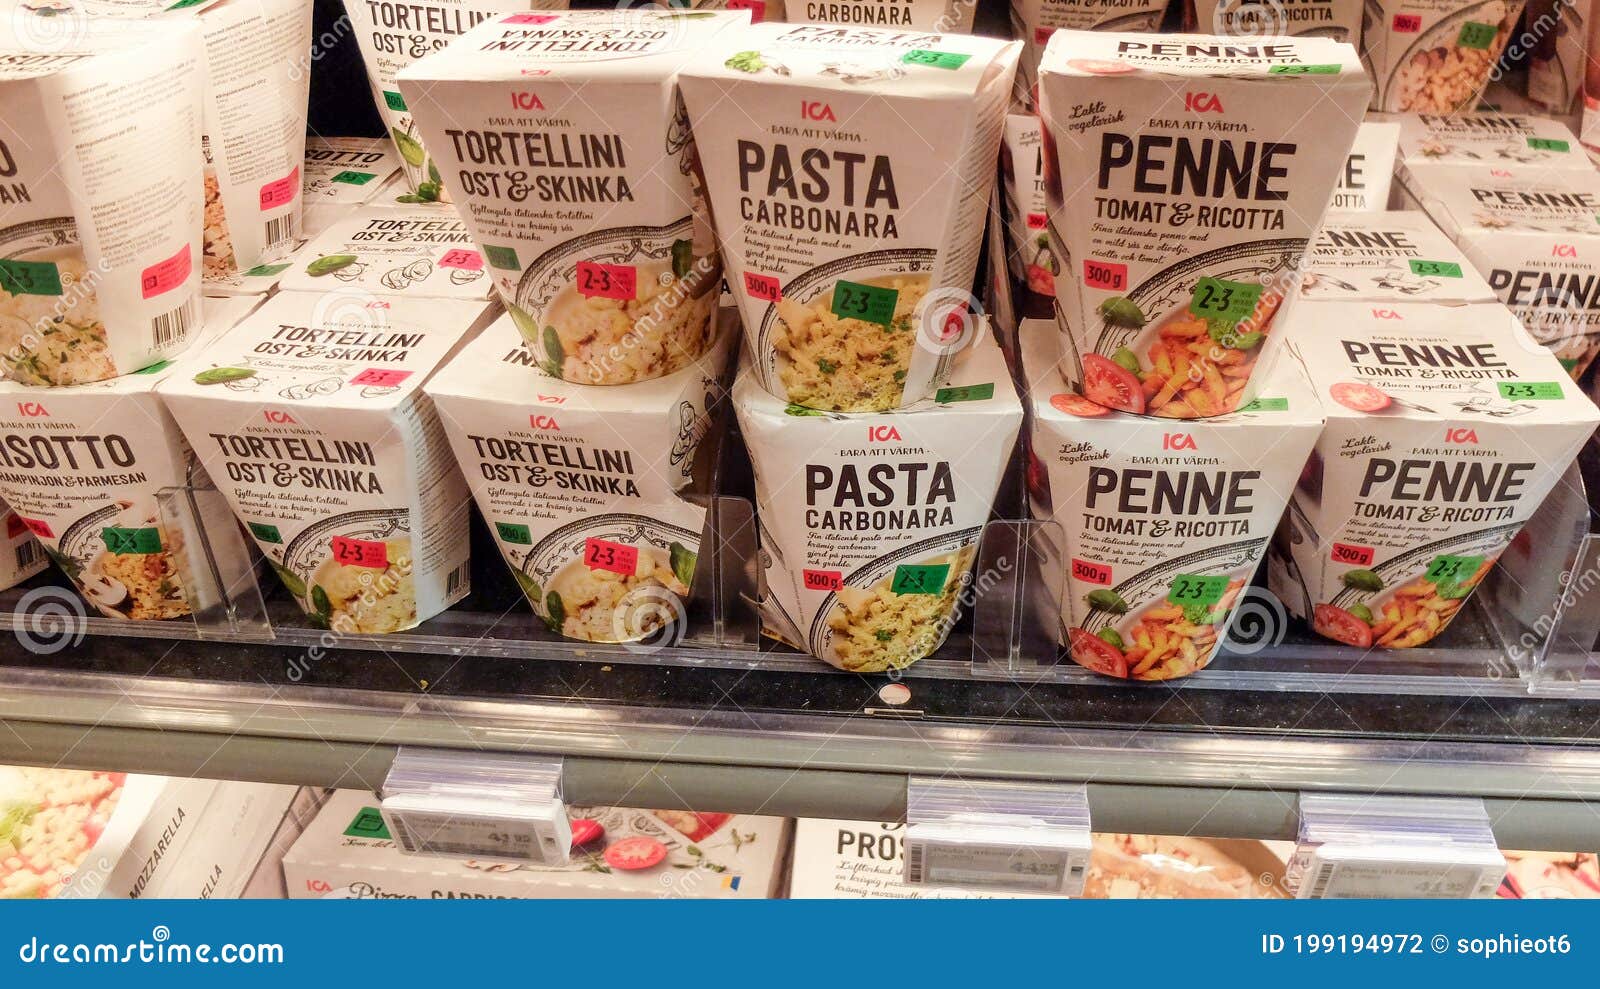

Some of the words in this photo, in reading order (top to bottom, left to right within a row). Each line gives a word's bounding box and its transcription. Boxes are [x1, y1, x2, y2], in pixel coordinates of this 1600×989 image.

[807, 4, 913, 25] CARBONARA
[1280, 8, 1333, 22] RICOTTA
[789, 26, 943, 43] PASTA
[373, 32, 404, 53] OST
[409, 35, 431, 59] &
[1118, 41, 1295, 58] PENNE
[1118, 54, 1181, 63] TOMAT
[512, 93, 545, 110] ICA
[1185, 92, 1224, 114] ICA
[801, 101, 836, 122] ICA
[1069, 102, 1107, 119] Lakto
[488, 118, 514, 126] BARA
[518, 118, 535, 127] ATT
[537, 117, 570, 128] VÄRMA
[1069, 110, 1126, 133] vegetarisk
[1150, 118, 1178, 129] BARA
[1180, 119, 1201, 131] ATT
[1204, 118, 1248, 133] VÄRMA
[771, 125, 799, 136] BARA
[801, 127, 820, 138] ATT
[823, 127, 861, 142] VÄRMA
[446, 130, 626, 169] TORTELLINI
[737, 139, 899, 210] PASTA
[1098, 132, 1297, 201] PENNE
[460, 170, 501, 199] OST
[507, 171, 536, 202] &
[539, 176, 634, 202] SKINKA
[1470, 188, 1600, 208] PENNE
[740, 197, 899, 239] CARBONARA
[1095, 197, 1166, 225] TOMAT
[1168, 202, 1194, 227] &
[1197, 206, 1285, 230] RICOTTA
[351, 231, 388, 241] OST
[412, 232, 473, 243] SKINK
[1115, 225, 1158, 239] italienska
[1159, 231, 1188, 241] penne
[1189, 232, 1210, 242] med
[1315, 231, 1417, 249] ENNE
[446, 252, 471, 264] 2-3
[1360, 249, 1423, 257] TRYFFEL
[1552, 244, 1577, 258] ICA
[1087, 265, 1111, 285] 300
[1114, 272, 1122, 288] g
[1416, 263, 1440, 274] 2-3
[583, 269, 611, 291] 2-3
[747, 277, 768, 293] 300
[769, 283, 777, 299] g
[366, 301, 390, 310] ICA
[840, 288, 870, 314] 2-3
[1198, 285, 1234, 312] 2-3
[1372, 308, 1404, 320] ICA
[272, 325, 426, 348] TORTELLINI
[253, 342, 297, 355] OST
[296, 344, 322, 358] &
[325, 348, 408, 362] SKINKA
[1341, 340, 1506, 368] PENNE
[360, 371, 389, 382] 2-3
[1352, 365, 1412, 379] TOMAT
[1420, 368, 1439, 379] &
[1439, 368, 1519, 380] RICOTTA
[1377, 381, 1412, 391] Buon
[1506, 385, 1536, 397] 2-3
[18, 403, 49, 417] ICA
[264, 411, 296, 424] ICA
[530, 415, 560, 430] ICA
[508, 431, 532, 440] BARA
[868, 426, 902, 442] ICA
[1162, 434, 1198, 450] ICA
[1342, 435, 1377, 449] Lakto
[1445, 428, 1478, 444] ICA
[209, 433, 376, 466] TORTELLINI
[467, 435, 634, 475] TORTELLINI
[840, 448, 867, 457] BARA
[869, 448, 887, 457] ATT
[890, 446, 925, 456] VÄRMA
[1060, 442, 1093, 454] Lakto
[1340, 442, 1392, 458] vegetarisk
[1412, 447, 1437, 456] BARA
[1440, 447, 1459, 456] ATT
[1060, 450, 1112, 464] vegetarisk
[1132, 456, 1160, 465] BARA
[1161, 456, 1181, 465] ATT
[1183, 455, 1219, 466] VÄRMA
[63, 476, 77, 487] &
[78, 472, 147, 487] PARMESAN
[226, 462, 266, 484] OST
[270, 462, 298, 487] &
[299, 467, 383, 494] SKINKA
[480, 463, 521, 484] OST
[525, 465, 556, 487] &
[556, 470, 641, 497] SKINKA
[806, 462, 956, 507] PASTA
[1359, 458, 1536, 502] PENNE
[1085, 466, 1261, 515] PENNE
[806, 506, 954, 530] CARBONARA
[1354, 502, 1416, 520] TOMAT
[1418, 505, 1441, 522] &
[1442, 505, 1515, 522] RICOTTA
[1083, 514, 1147, 536] TOMAT
[1149, 519, 1172, 538] &
[1174, 518, 1250, 538] RICOTTA
[825, 532, 858, 541] italiensk
[861, 533, 882, 543] pasta
[837, 541, 878, 550] carbonara
[1141, 541, 1165, 549] penne
[1167, 540, 1185, 548] med
[339, 542, 363, 561] 2-3
[591, 544, 615, 566] 2-3
[1336, 546, 1358, 560] 300
[1359, 552, 1369, 564] g
[1075, 563, 1097, 579] 300
[1098, 570, 1107, 583] g
[1432, 560, 1462, 577] 2-3
[808, 573, 828, 586] 300
[830, 577, 838, 588] g
[900, 571, 926, 588] 2-3
[1175, 580, 1206, 599] 2-3
[129, 807, 186, 899] MOZZARELLA
[306, 880, 333, 893] ICA
